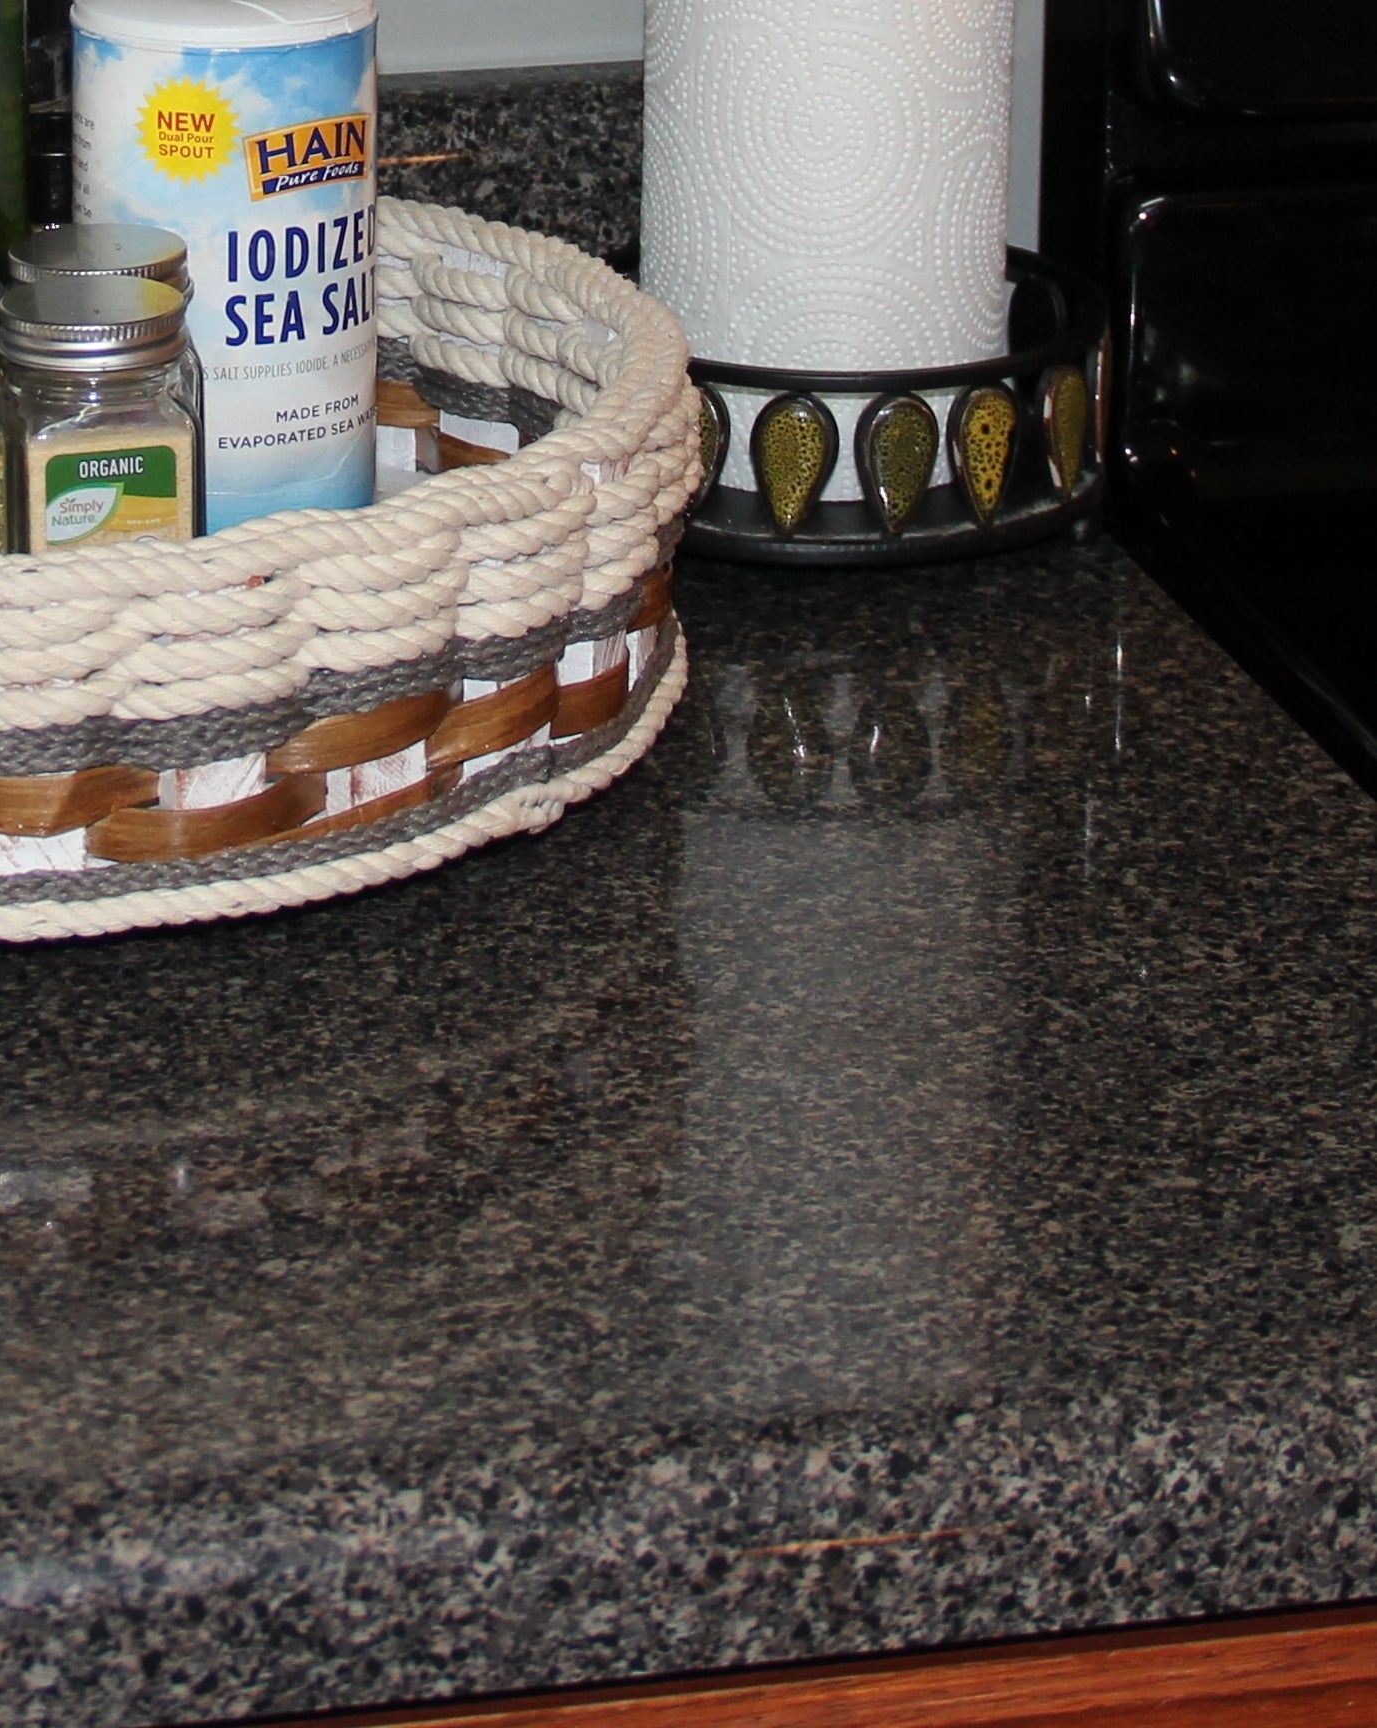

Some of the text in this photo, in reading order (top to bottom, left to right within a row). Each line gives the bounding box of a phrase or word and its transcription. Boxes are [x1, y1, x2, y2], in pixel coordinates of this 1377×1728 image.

[157, 110, 215, 132] NEW
[158, 131, 215, 143] Dual Pour
[158, 144, 215, 159] SPOUT
[256, 120, 365, 174] HAIN
[275, 161, 359, 192] Pure Foods
[228, 204, 375, 282] IODIZED
[225, 290, 305, 347] SEA
[213, 366, 239, 381] SALT
[243, 361, 292, 379] SUPPLIES
[332, 353, 340, 368] A
[276, 393, 359, 423] MADE FROM
[218, 426, 326, 450] EVAPORATED
[331, 418, 354, 436] SEA
[79, 456, 144, 479] ORGANIC
[60, 499, 104, 515] Simply
